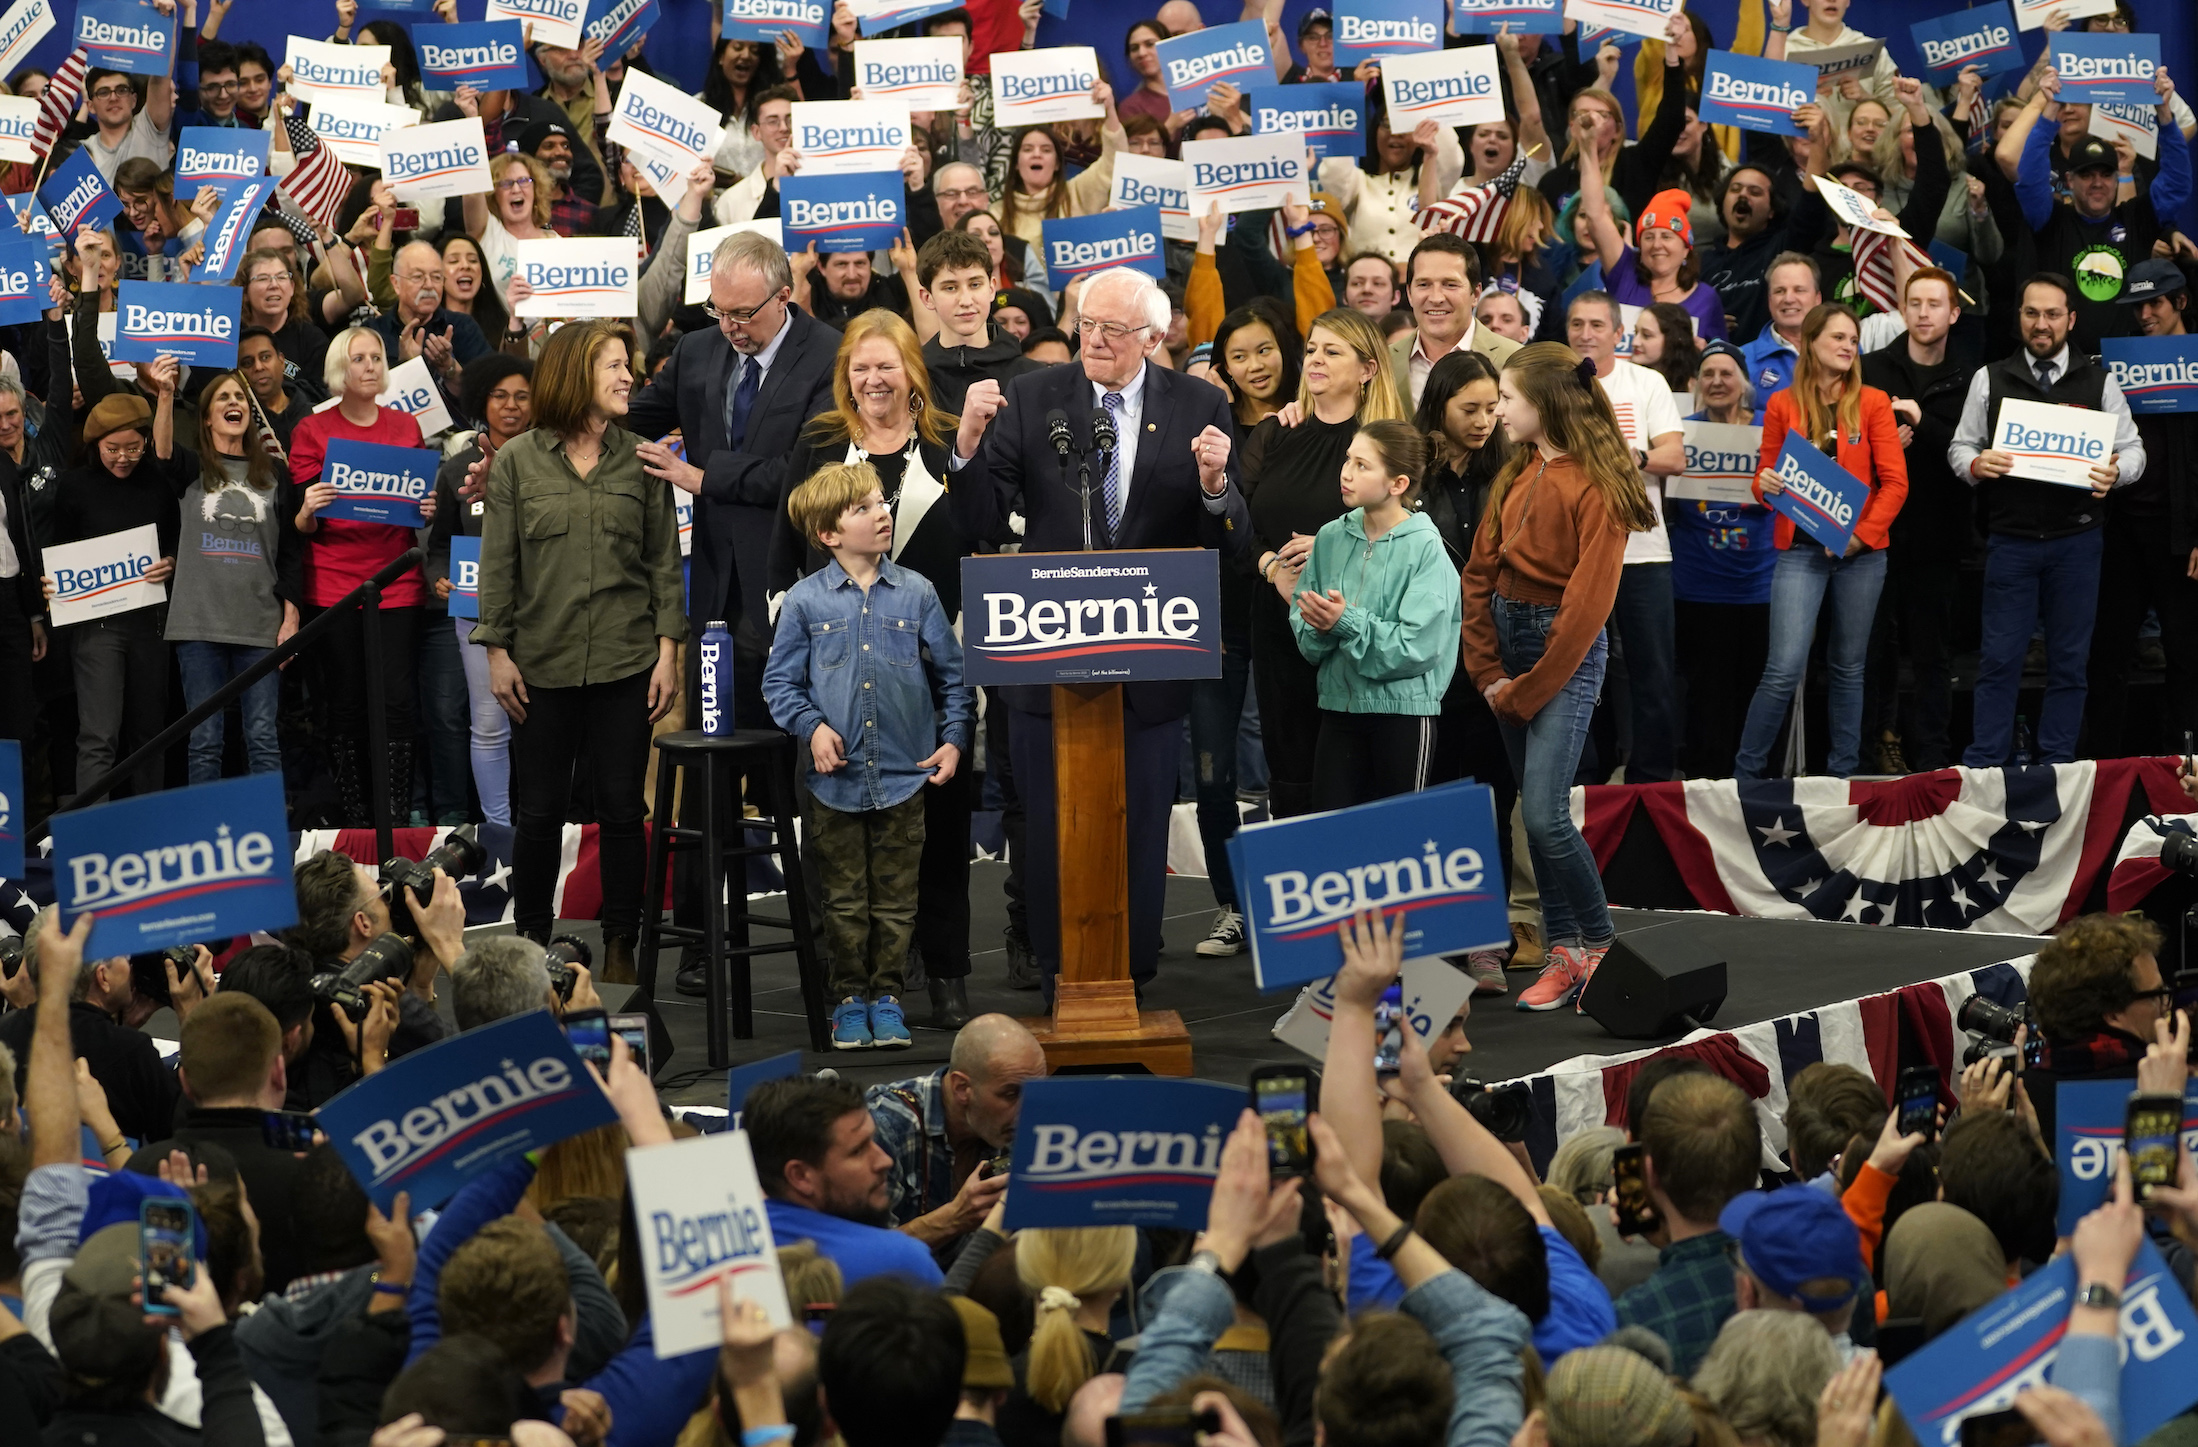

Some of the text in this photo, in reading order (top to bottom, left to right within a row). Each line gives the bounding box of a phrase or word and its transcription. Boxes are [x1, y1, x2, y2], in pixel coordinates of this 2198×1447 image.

[0, 1, 43, 51] ernie
[80, 16, 165, 51] Bernie
[1340, 16, 1437, 43] Bernie
[422, 40, 517, 68] Bernie
[1922, 24, 2010, 64] Bernie
[294, 56, 380, 86] Bernie
[865, 59, 956, 86] Bernie
[1169, 42, 1265, 84] Bernie
[2058, 52, 2154, 79] Bernie
[1001, 69, 1093, 98] Bernie
[1392, 70, 1491, 104] Bernie
[1708, 72, 1808, 107] Bernie
[624, 92, 707, 152] Bernie
[802, 121, 903, 149] Bernie
[1259, 103, 1358, 134] Bernie
[179, 148, 259, 178] Bernie
[387, 142, 479, 176] Bernie
[1194, 155, 1299, 187] Bernie
[50, 174, 102, 231] Bernie
[789, 193, 896, 226] Bernie
[1119, 177, 1189, 209] Bern
[206, 183, 260, 274] Bernie
[1052, 228, 1156, 266] Bernie
[526, 260, 628, 290] Bernie
[124, 305, 232, 338] Bernie
[2003, 422, 2104, 460] Bernie
[1684, 445, 1760, 472] Berni
[330, 462, 426, 499] Bernie
[1778, 452, 1854, 527] Bernie
[202, 532, 261, 555] Bernie
[1709, 528, 1750, 550] US
[54, 551, 154, 595] Bernie
[1031, 565, 1149, 580] BernieSanders.com
[984, 583, 1200, 643] Bernie
[701, 642, 721, 734] Bernie
[69, 823, 275, 904] Bernie
[1265, 838, 1485, 925] Bernie
[352, 1057, 573, 1178] Bernie
[1027, 1122, 1224, 1174] Berni
[652, 1196, 765, 1272] Bernie
